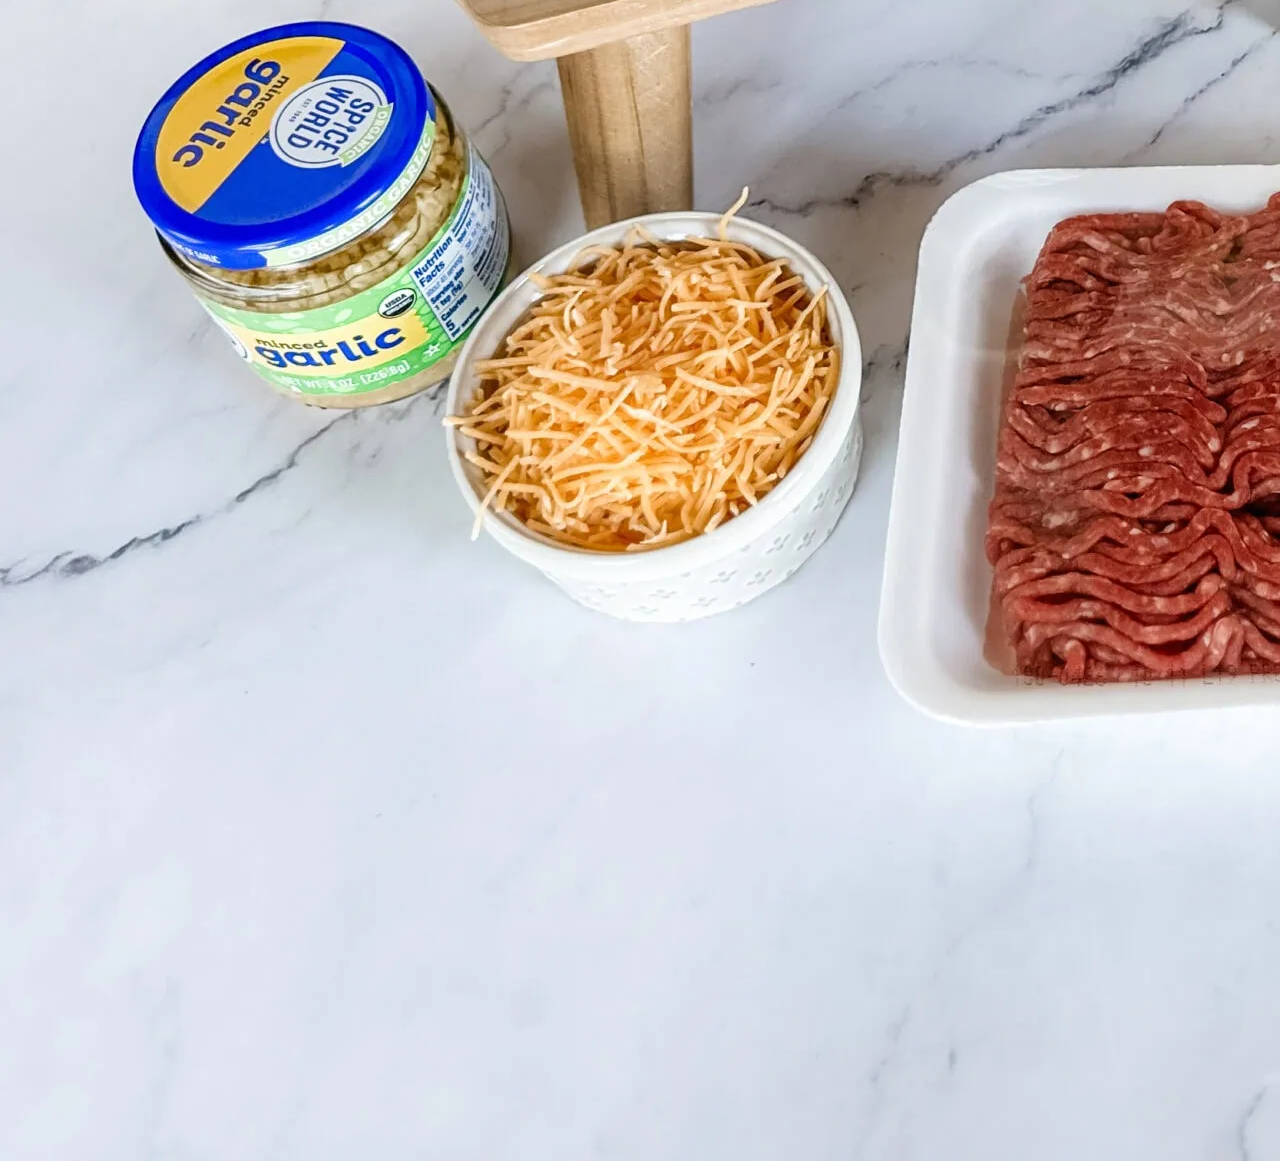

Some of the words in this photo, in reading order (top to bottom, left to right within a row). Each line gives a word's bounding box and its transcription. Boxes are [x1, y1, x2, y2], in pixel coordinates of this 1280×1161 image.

[172, 58, 281, 167] garlic
[237, 75, 290, 127] minced
[287, 86, 353, 148] WORLD
[314, 98, 374, 155] SPICE
[347, 110, 389, 159] ORGANIC
[288, 203, 386, 258] ORGANIC
[389, 133, 431, 201] GARLIC
[414, 236, 453, 279] Nutrition
[419, 261, 445, 287] Facts
[385, 293, 407, 308] USDA
[430, 281, 455, 304] Serving
[441, 293, 467, 321] Calories
[255, 338, 328, 350] minced
[446, 319, 455, 331] 5
[255, 327, 406, 368] garlic
